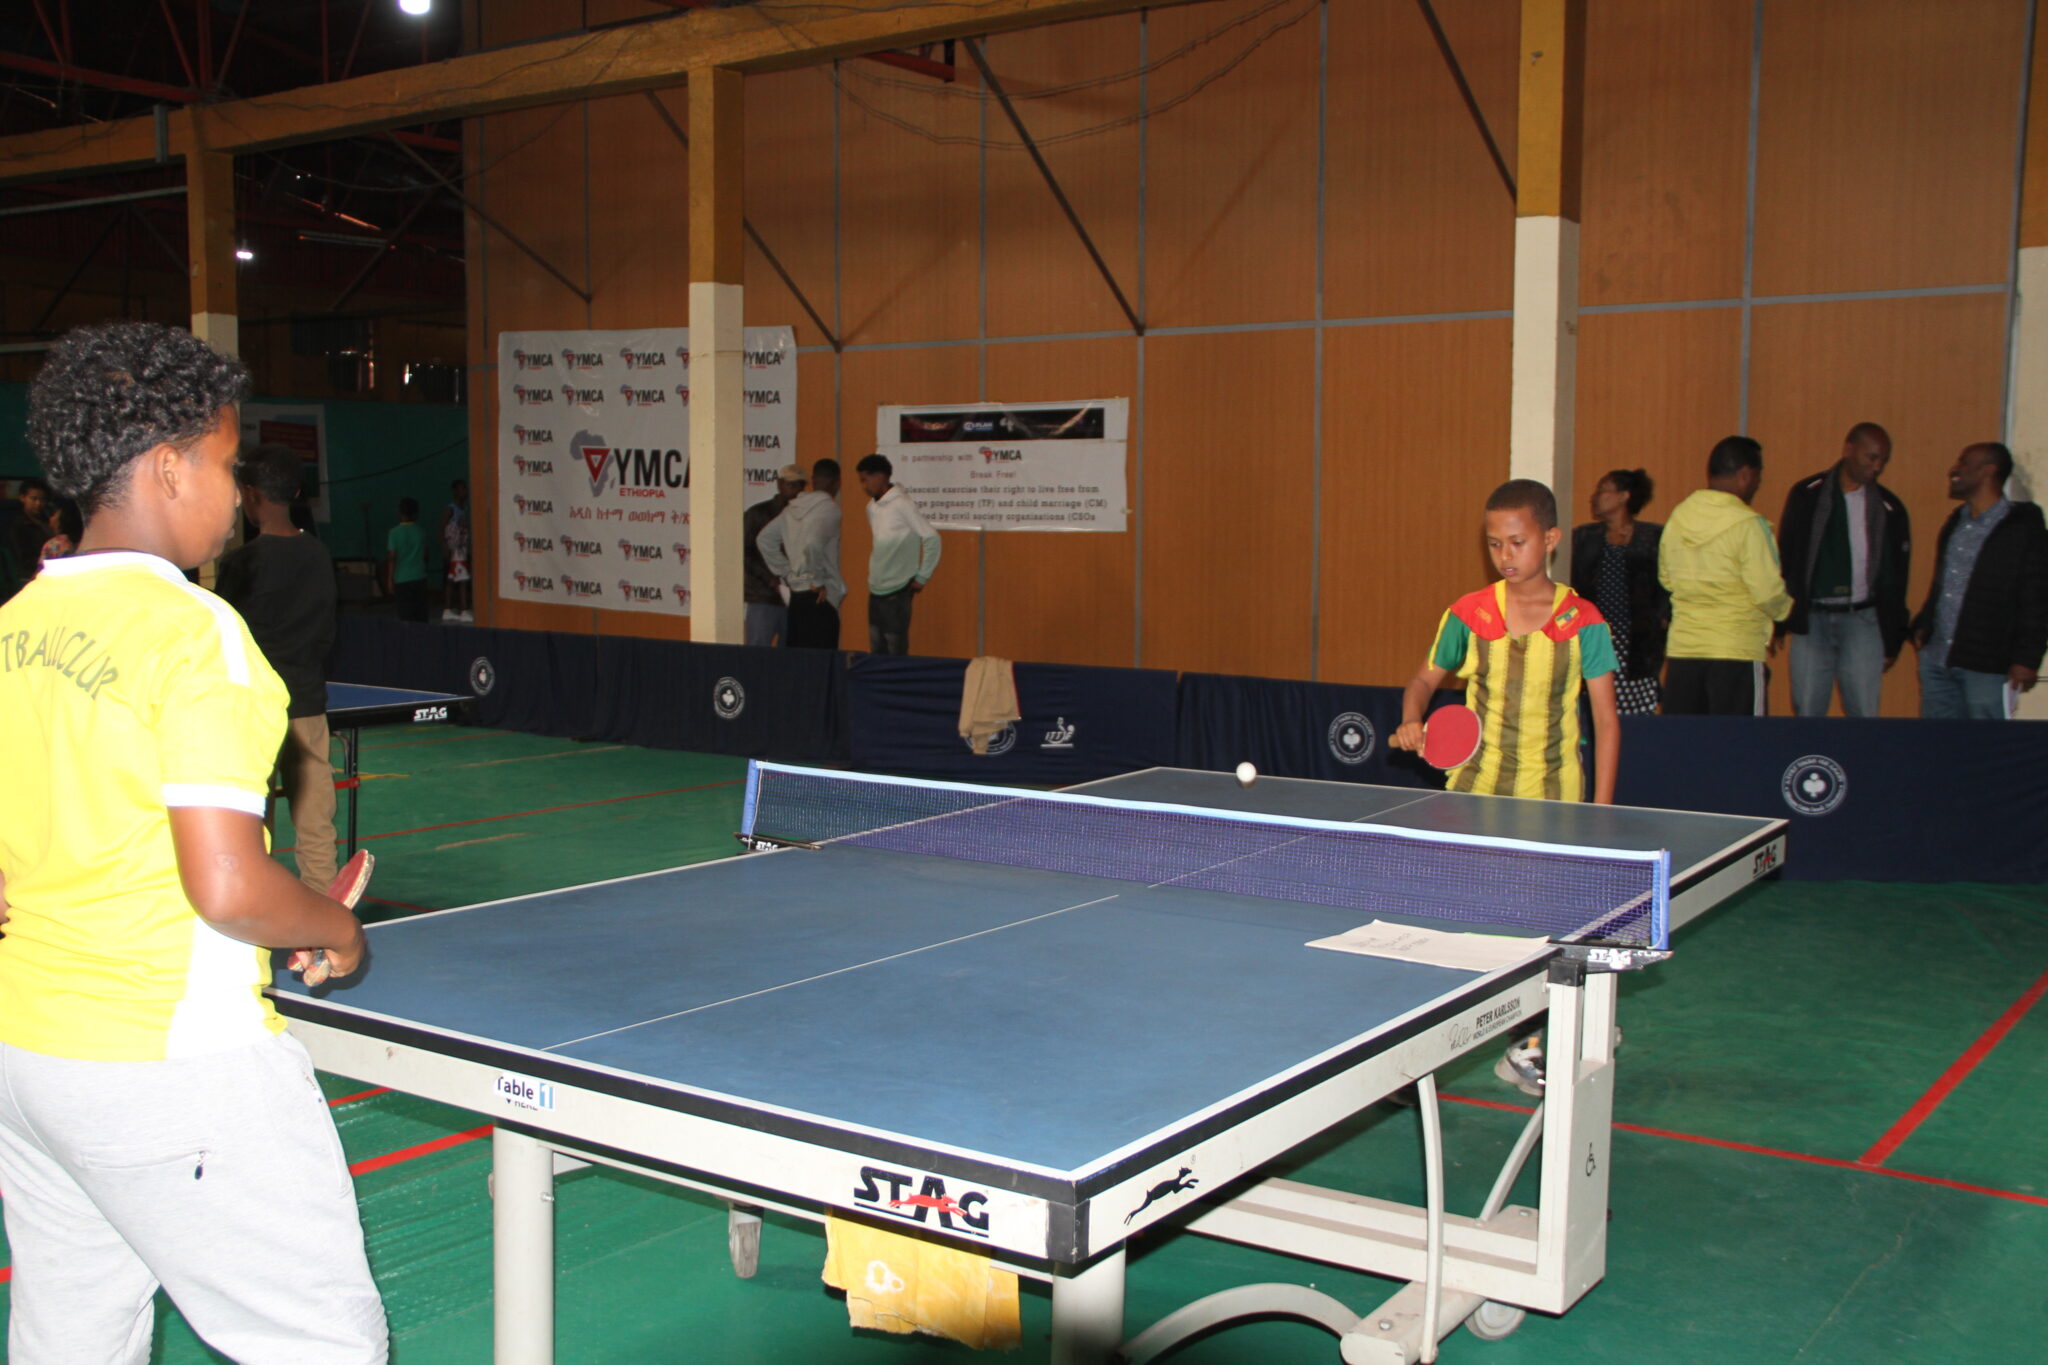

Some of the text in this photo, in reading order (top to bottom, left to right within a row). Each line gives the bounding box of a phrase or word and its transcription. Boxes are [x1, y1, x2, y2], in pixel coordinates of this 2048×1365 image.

[526, 354, 553, 366] YMCA
[575, 353, 603, 366] YMCA
[635, 352, 666, 366] YMCA
[748, 351, 781, 365] YMCA
[526, 389, 553, 402] YMCA
[575, 389, 604, 402] YMCA
[635, 390, 665, 402] YMCA
[748, 390, 781, 404] YMCA
[526, 429, 553, 442] YMCA
[747, 434, 780, 448] YMCA
[993, 449, 1022, 460] YMCA
[526, 460, 553, 473] YMCA
[614, 449, 689, 488] YMC
[747, 468, 779, 482] YMCA
[619, 488, 666, 498] ETHIOPIA
[526, 499, 553, 513] YMCA
[526, 537, 553, 551] YMCA
[574, 541, 602, 554] YMCA
[633, 545, 662, 559] YMCA
[526, 577, 553, 591] YMCA
[574, 580, 603, 595] YMCA
[633, 585, 663, 600] YMCA
[413, 705, 448, 721] STAG
[1753, 844, 1777, 877] STAG
[1588, 949, 1632, 967] STAG
[1475, 996, 1521, 1029] PETER KARLSSON
[854, 1166, 989, 1232] STAG
